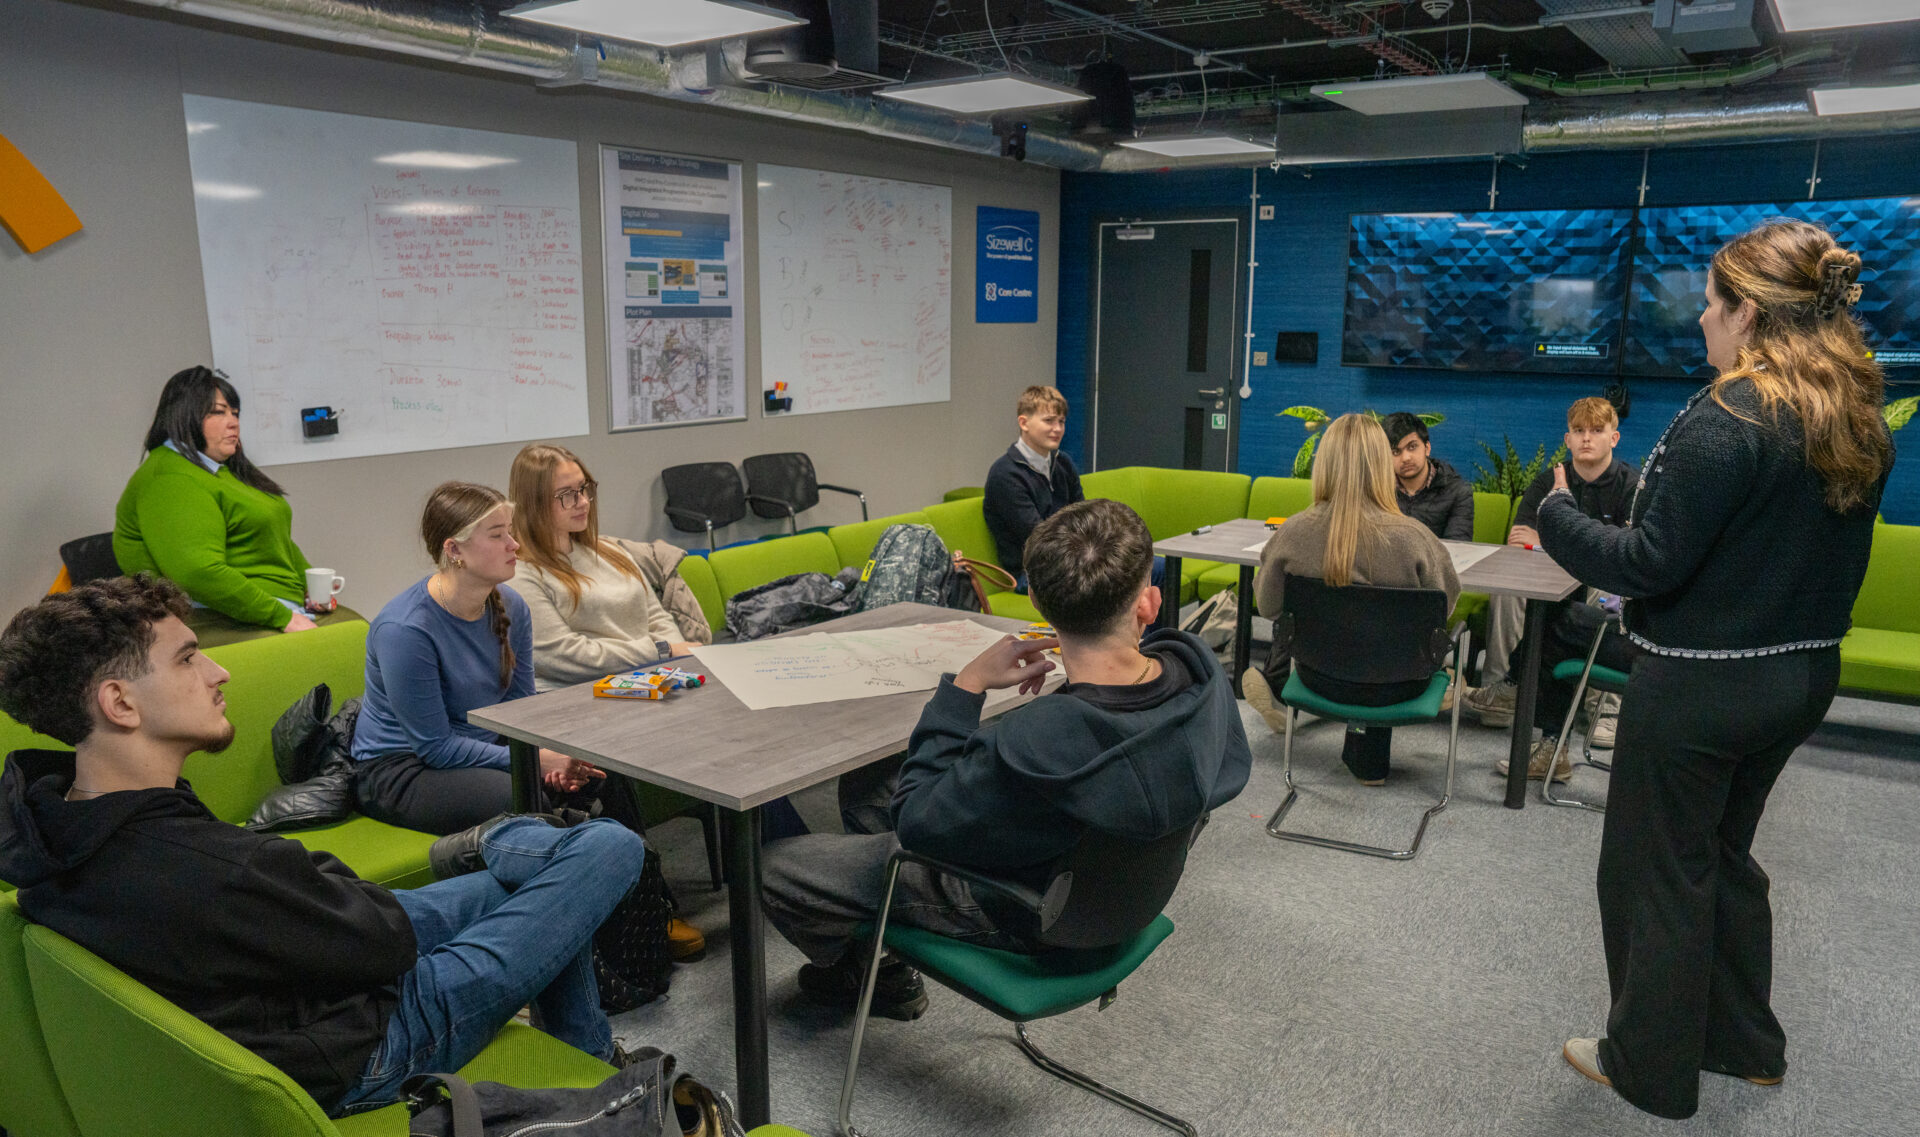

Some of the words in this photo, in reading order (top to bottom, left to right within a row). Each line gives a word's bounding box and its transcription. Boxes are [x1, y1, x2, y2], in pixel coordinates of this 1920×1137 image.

[622, 208, 641, 218] Digital
[641, 210, 659, 219] Vision
[986, 234, 1023, 252] Sizewell
[1024, 237, 1033, 253] C
[626, 307, 639, 315] Plot
[640, 308, 653, 316] Plan
